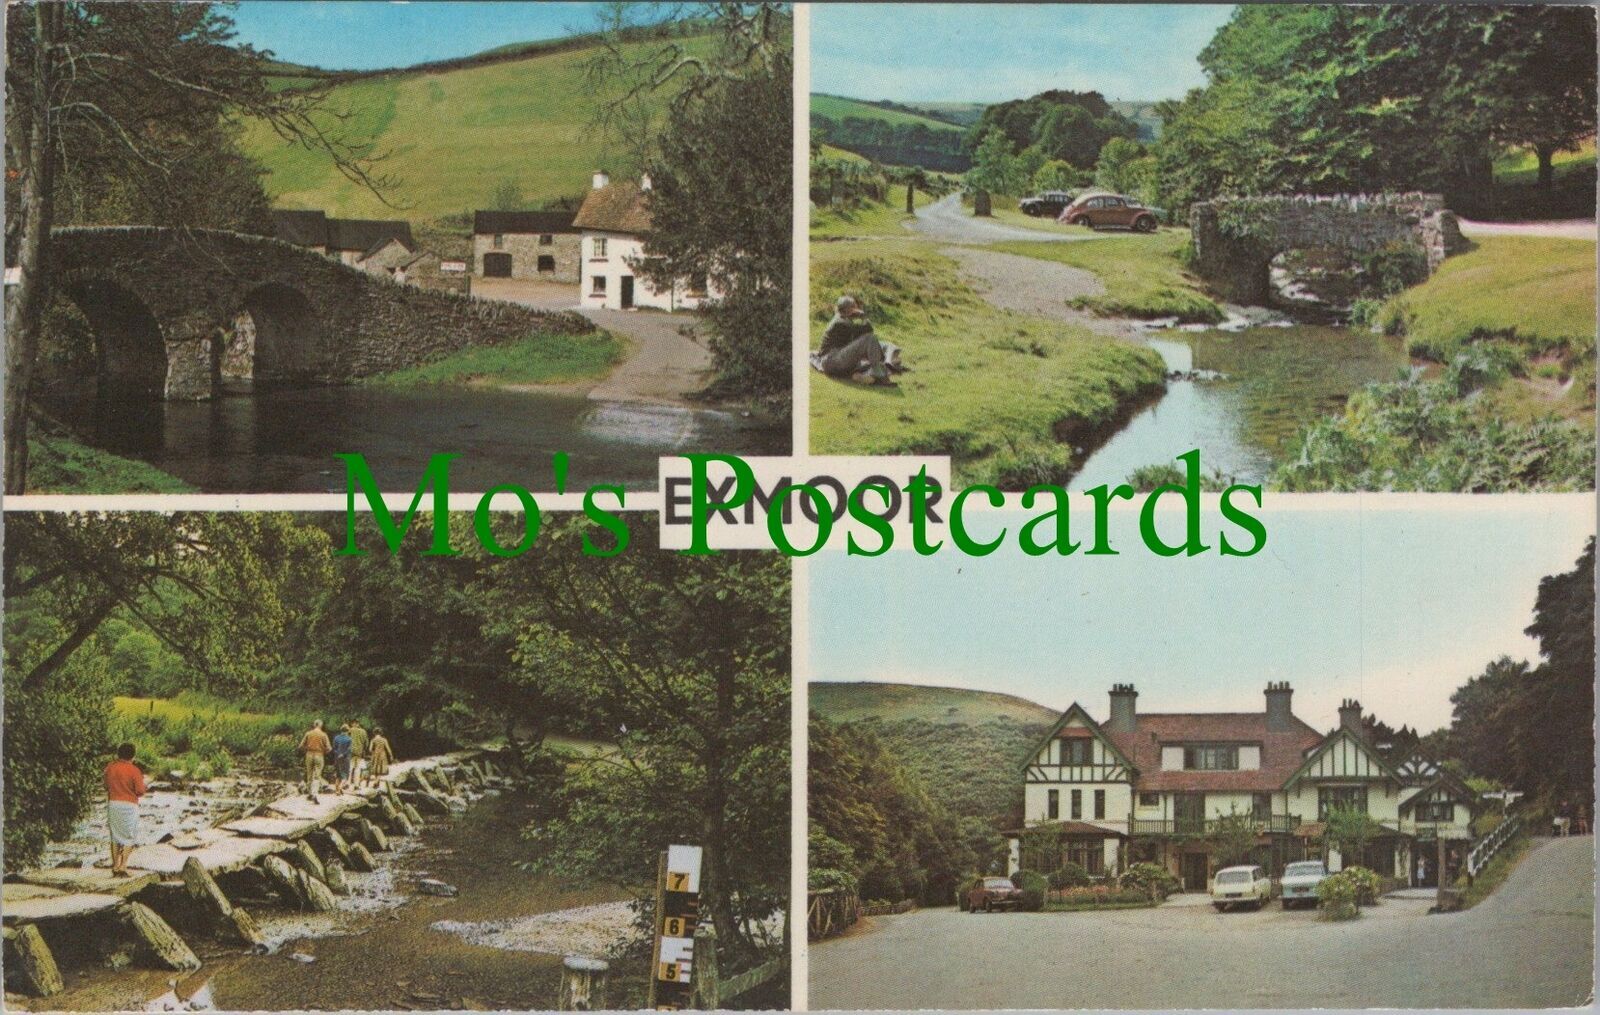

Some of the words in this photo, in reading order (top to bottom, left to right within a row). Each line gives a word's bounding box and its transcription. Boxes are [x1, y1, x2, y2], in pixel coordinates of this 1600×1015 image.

[665, 475, 943, 525] EXMOOR
[673, 872, 686, 890] 7
[669, 919, 680, 935] 6
[665, 963, 677, 980] 5
